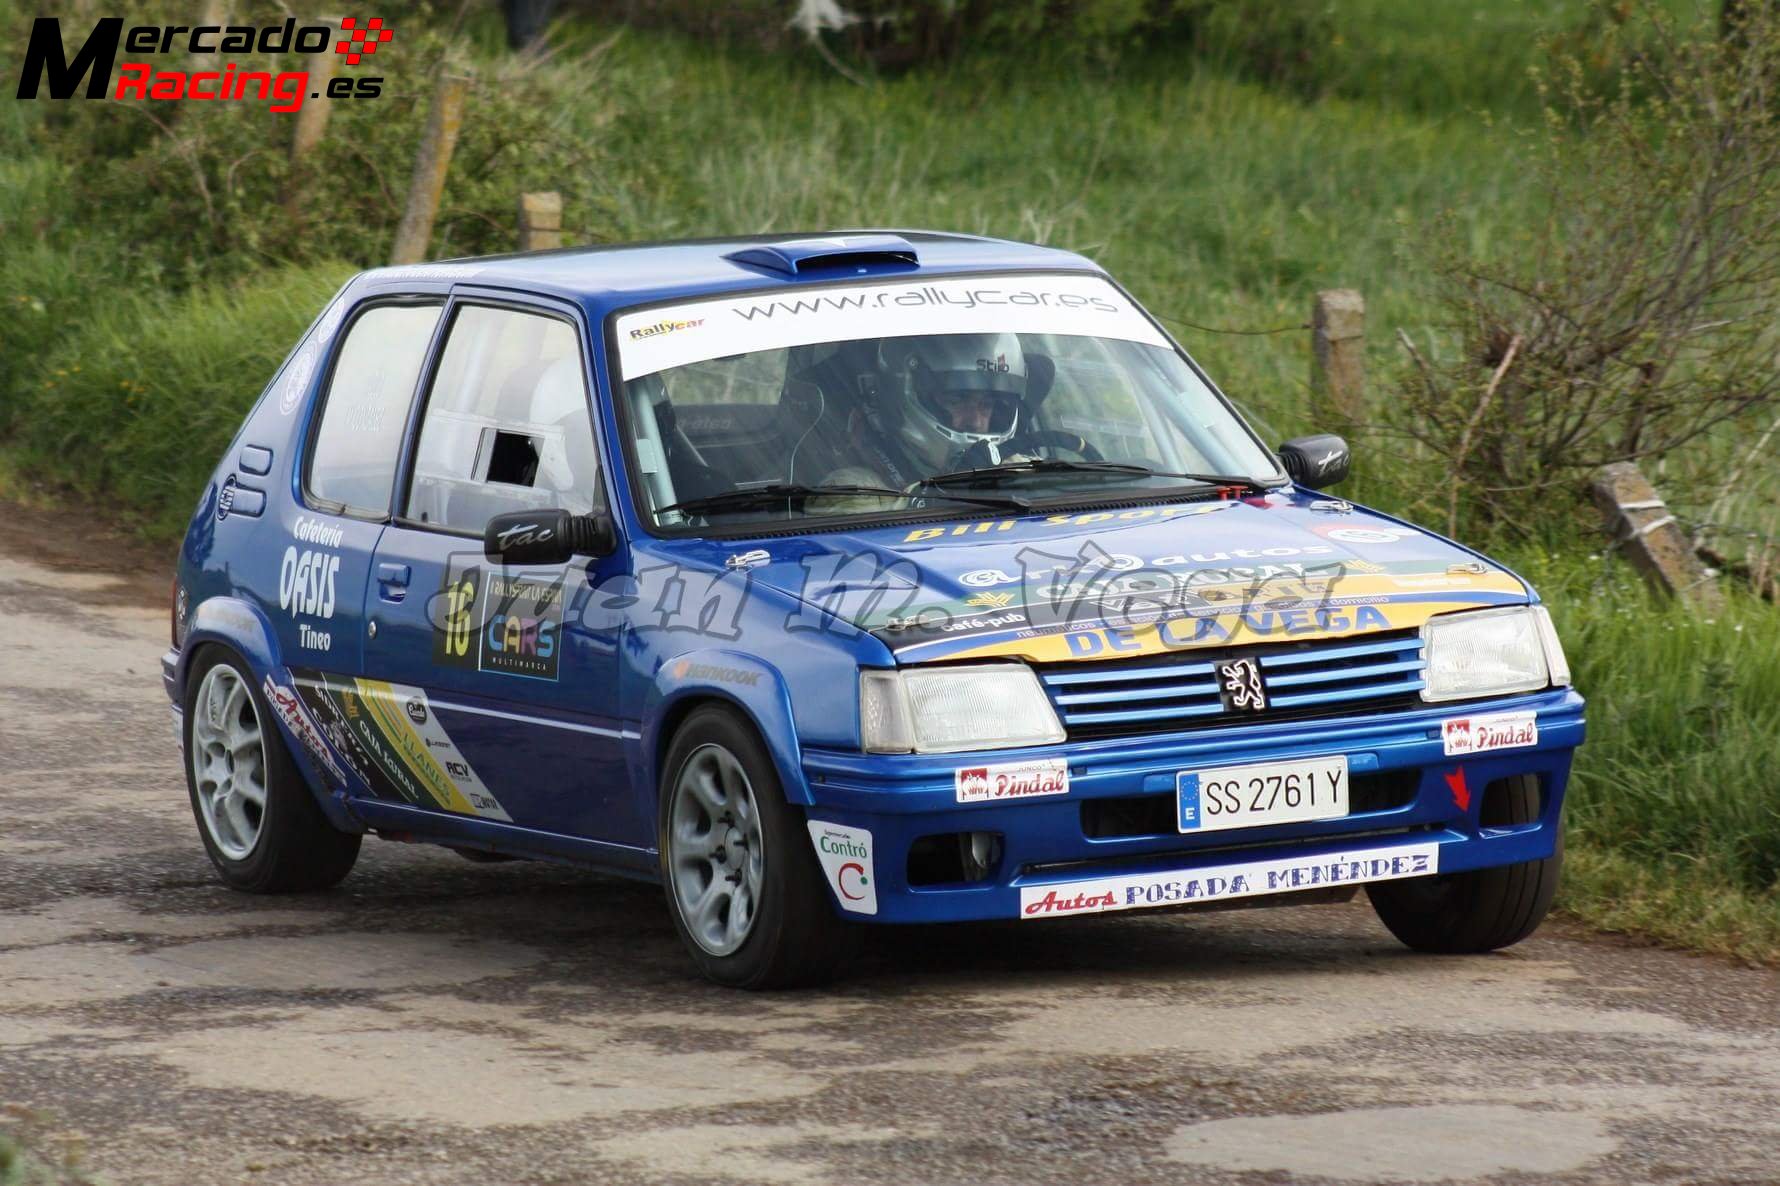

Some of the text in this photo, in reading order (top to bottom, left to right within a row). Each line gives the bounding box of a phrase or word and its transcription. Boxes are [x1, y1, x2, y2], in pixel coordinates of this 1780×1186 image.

[731, 286, 1119, 321] www.rallycar.es
[629, 318, 706, 342] Rallycar
[496, 523, 555, 551] tac
[279, 545, 341, 620] OASIS
[299, 623, 332, 652] Tineo
[488, 614, 555, 658] CARS
[1063, 605, 1392, 657] DE LA VEGA
[1476, 722, 1534, 749] Pindal
[994, 770, 1065, 797] Pindal
[1206, 769, 1343, 815] SS 2761 Y
[1184, 807, 1196, 821] E
[820, 835, 869, 858] Contró
[1025, 853, 1431, 914] Autos POSADA MENÉNDEZ
